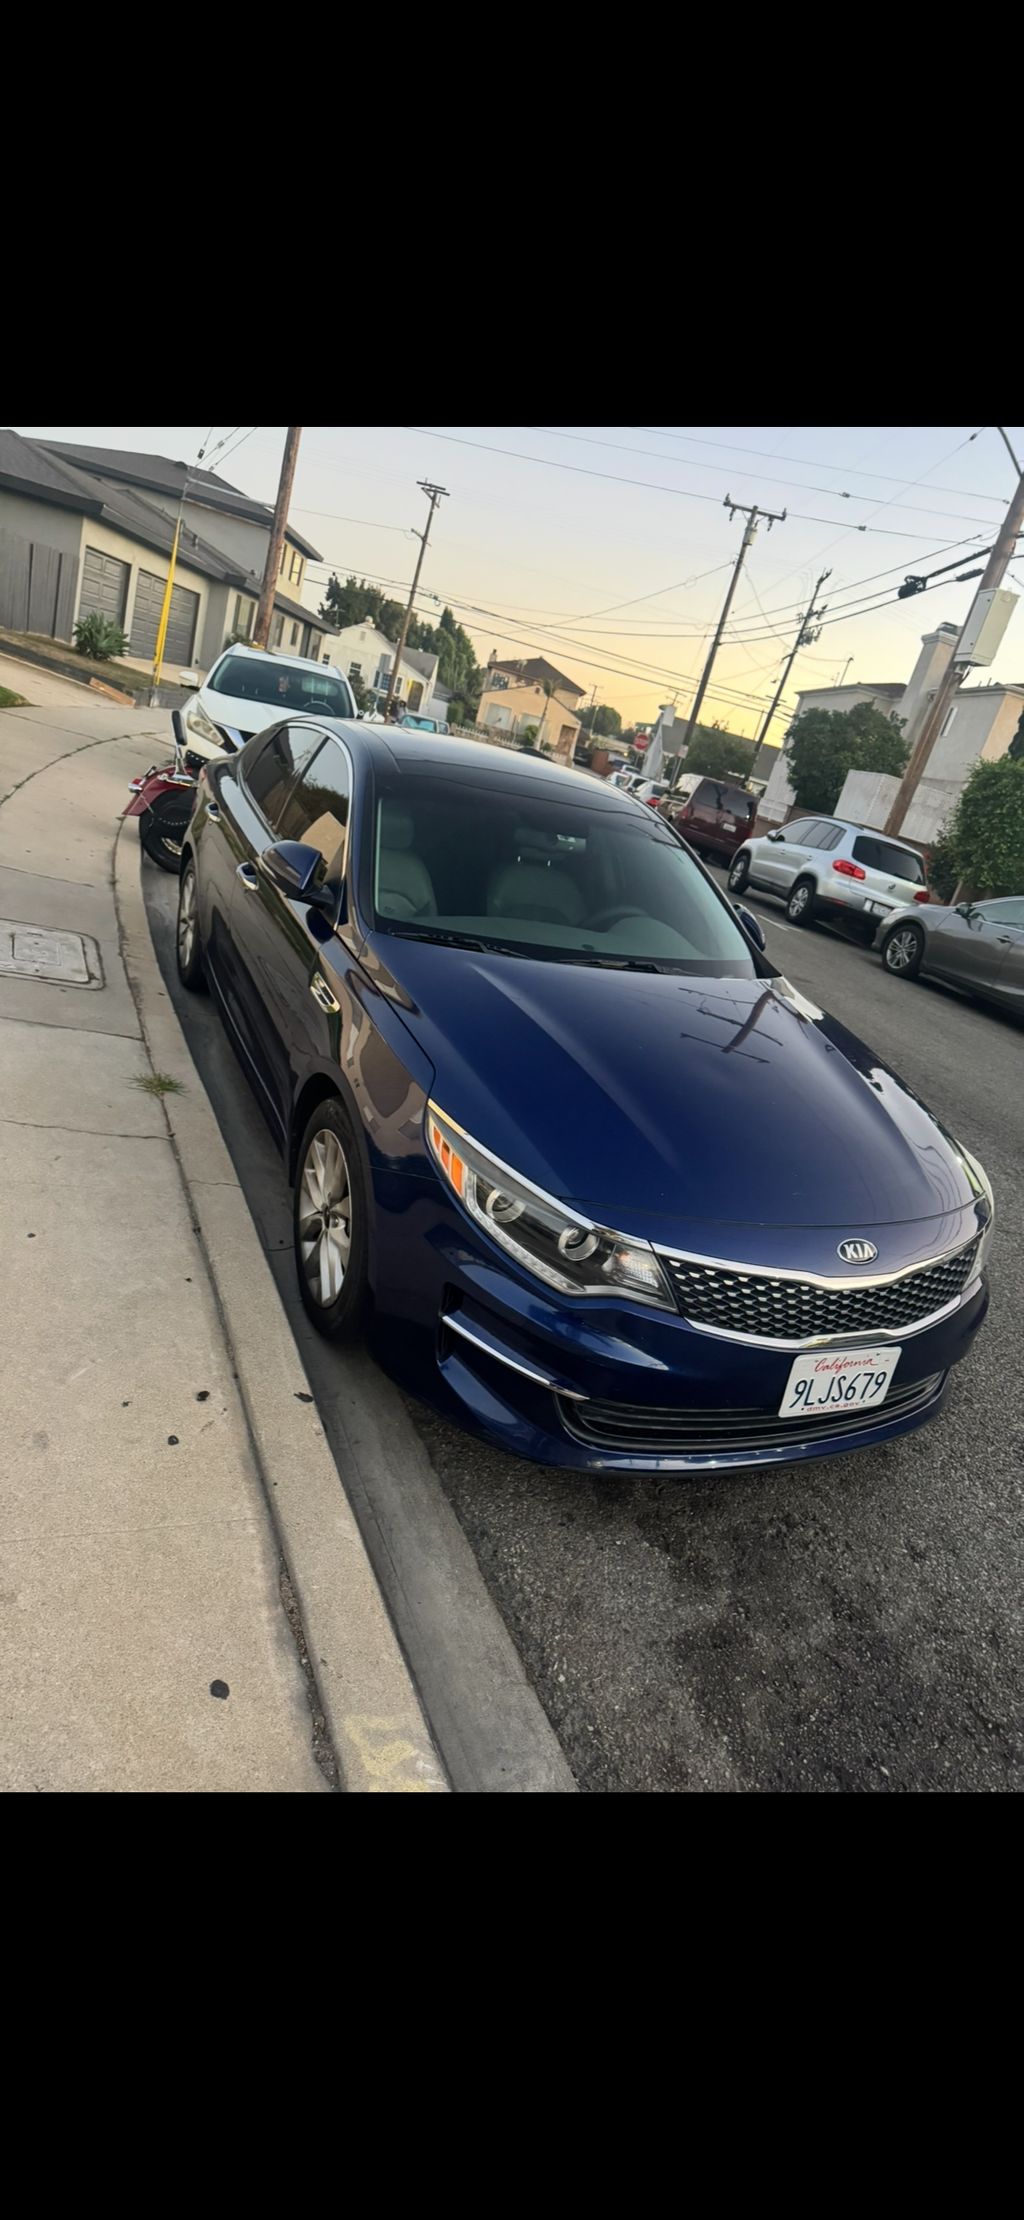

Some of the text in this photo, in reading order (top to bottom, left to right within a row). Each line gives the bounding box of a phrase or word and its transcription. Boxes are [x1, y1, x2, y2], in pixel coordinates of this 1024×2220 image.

[843, 1243, 873, 1259] KIA
[814, 1357, 879, 1374] California
[789, 1371, 887, 1408] 9LJS679
